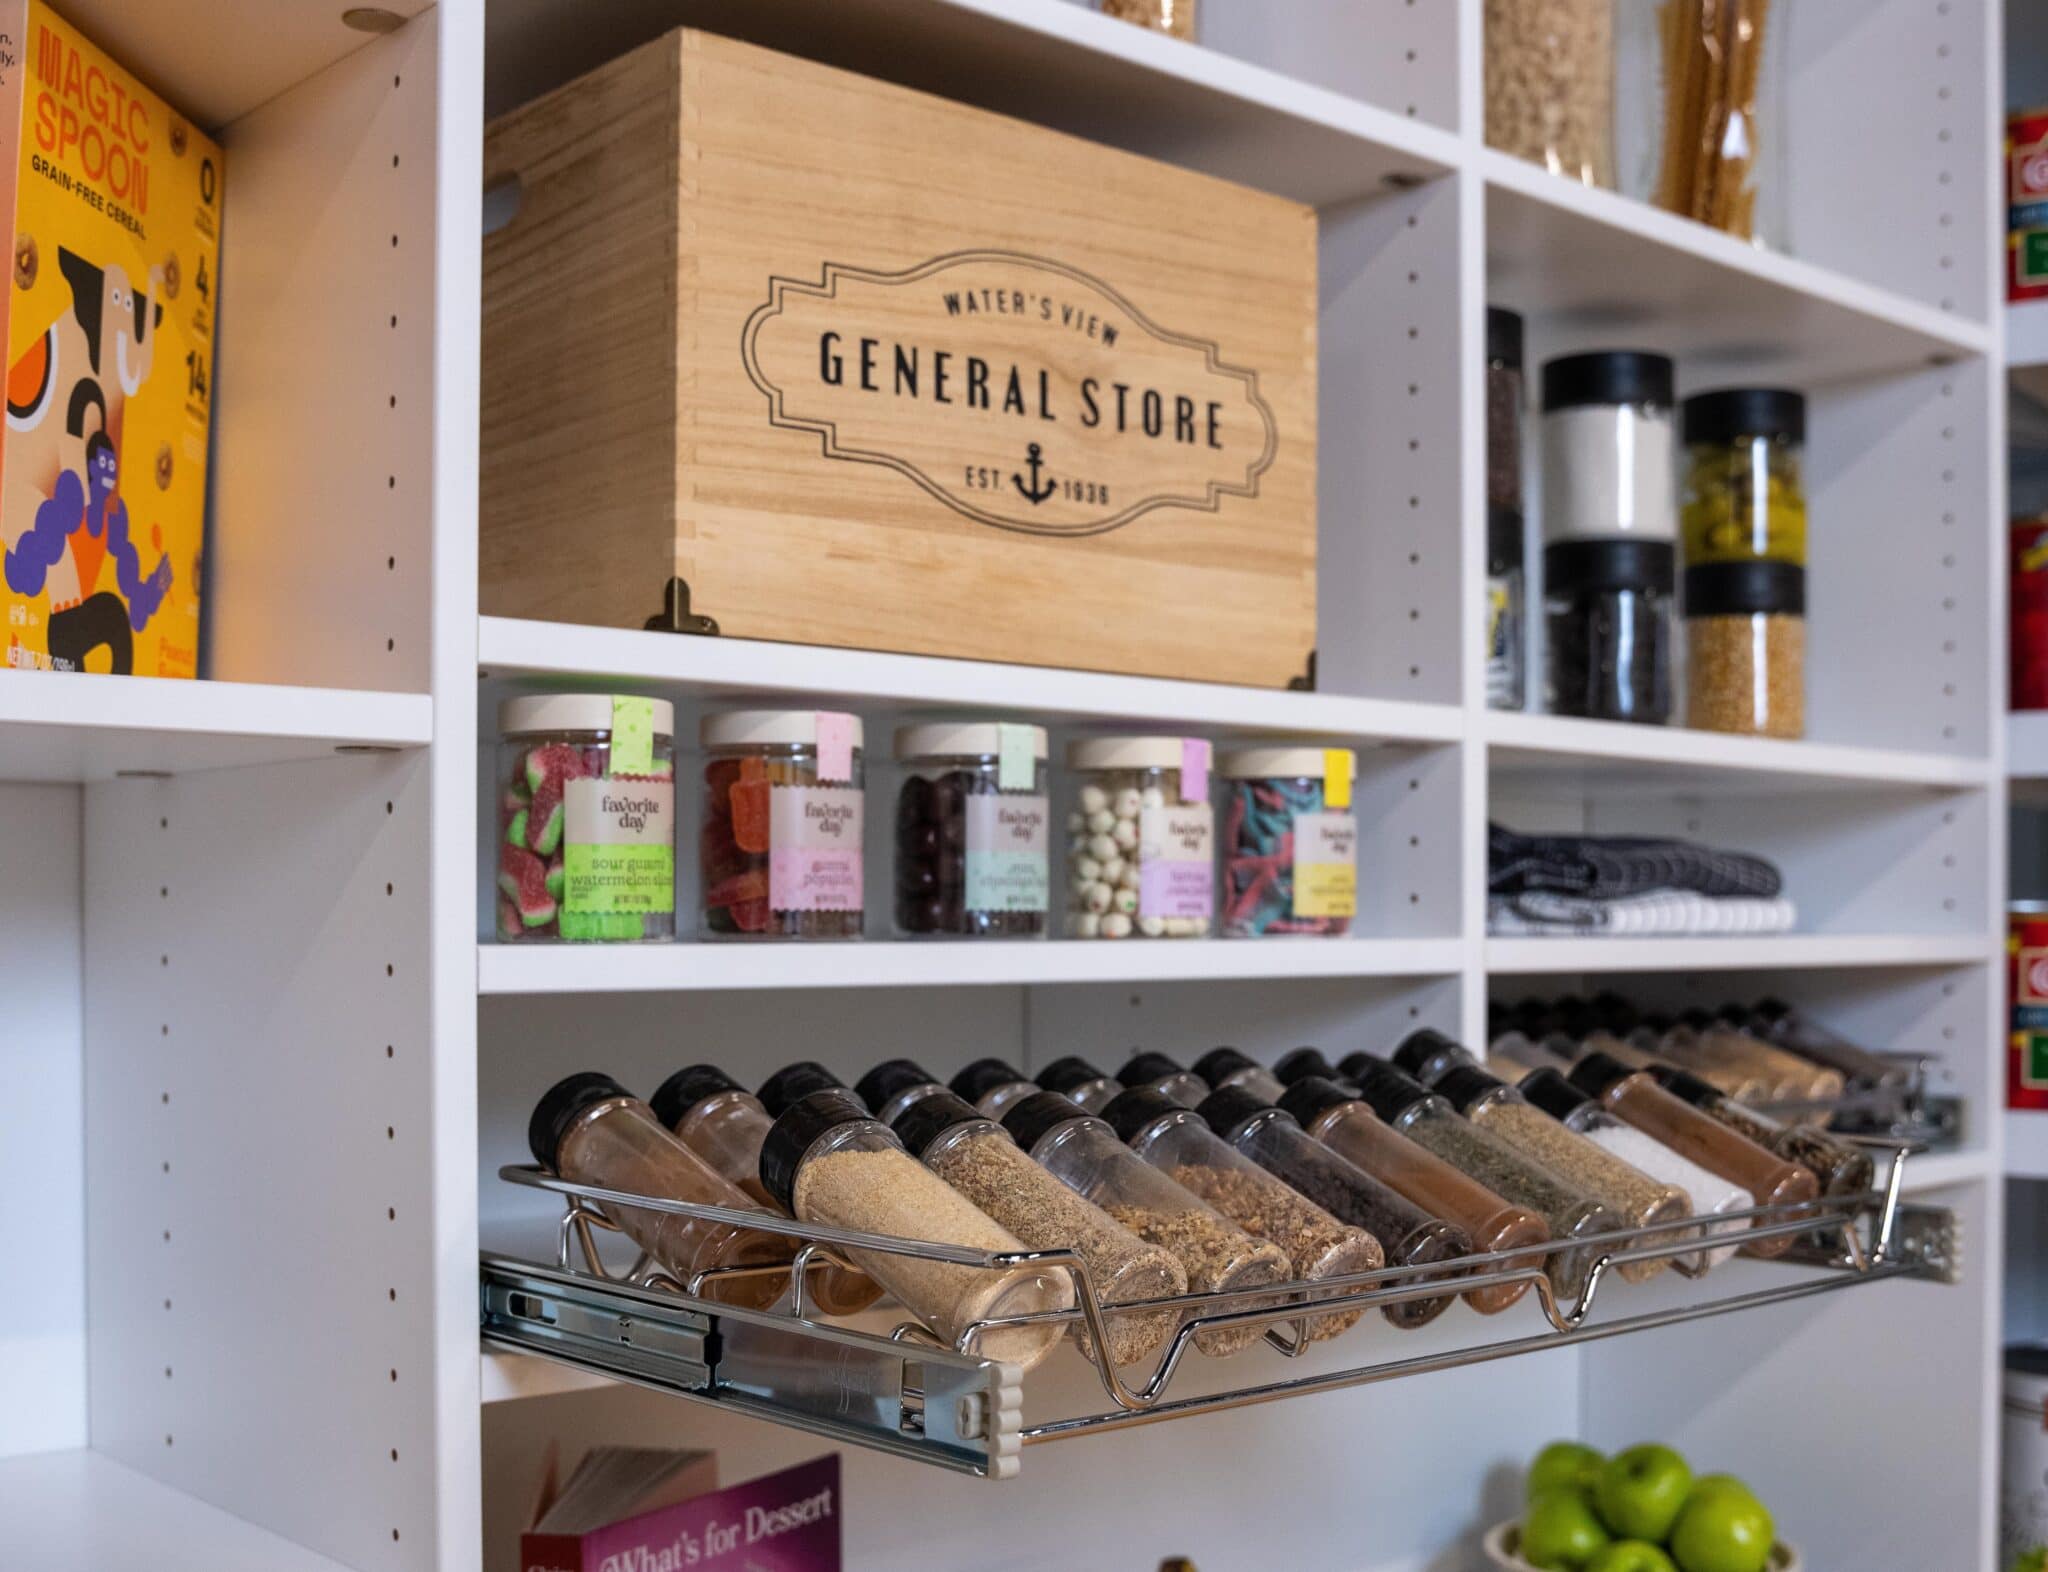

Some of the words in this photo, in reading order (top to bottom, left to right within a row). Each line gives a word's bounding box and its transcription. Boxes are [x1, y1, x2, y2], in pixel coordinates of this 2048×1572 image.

[37, 24, 149, 155] MAGIC
[35, 91, 149, 216] SPOON
[31, 153, 105, 213] GRAIN-FREE
[106, 202, 147, 241] CEREAL
[943, 289, 1052, 320] WATER'S
[1061, 303, 1119, 347] VIEW
[819, 331, 1056, 421] GENERAL
[1080, 377, 1223, 450] STORE
[602, 795, 660, 814] favorite
[618, 812, 648, 834] day
[804, 801, 854, 819] favorite
[600, 1529, 700, 1572] What's
[703, 1520, 741, 1559] for
[745, 1486, 833, 1543] Dessert
